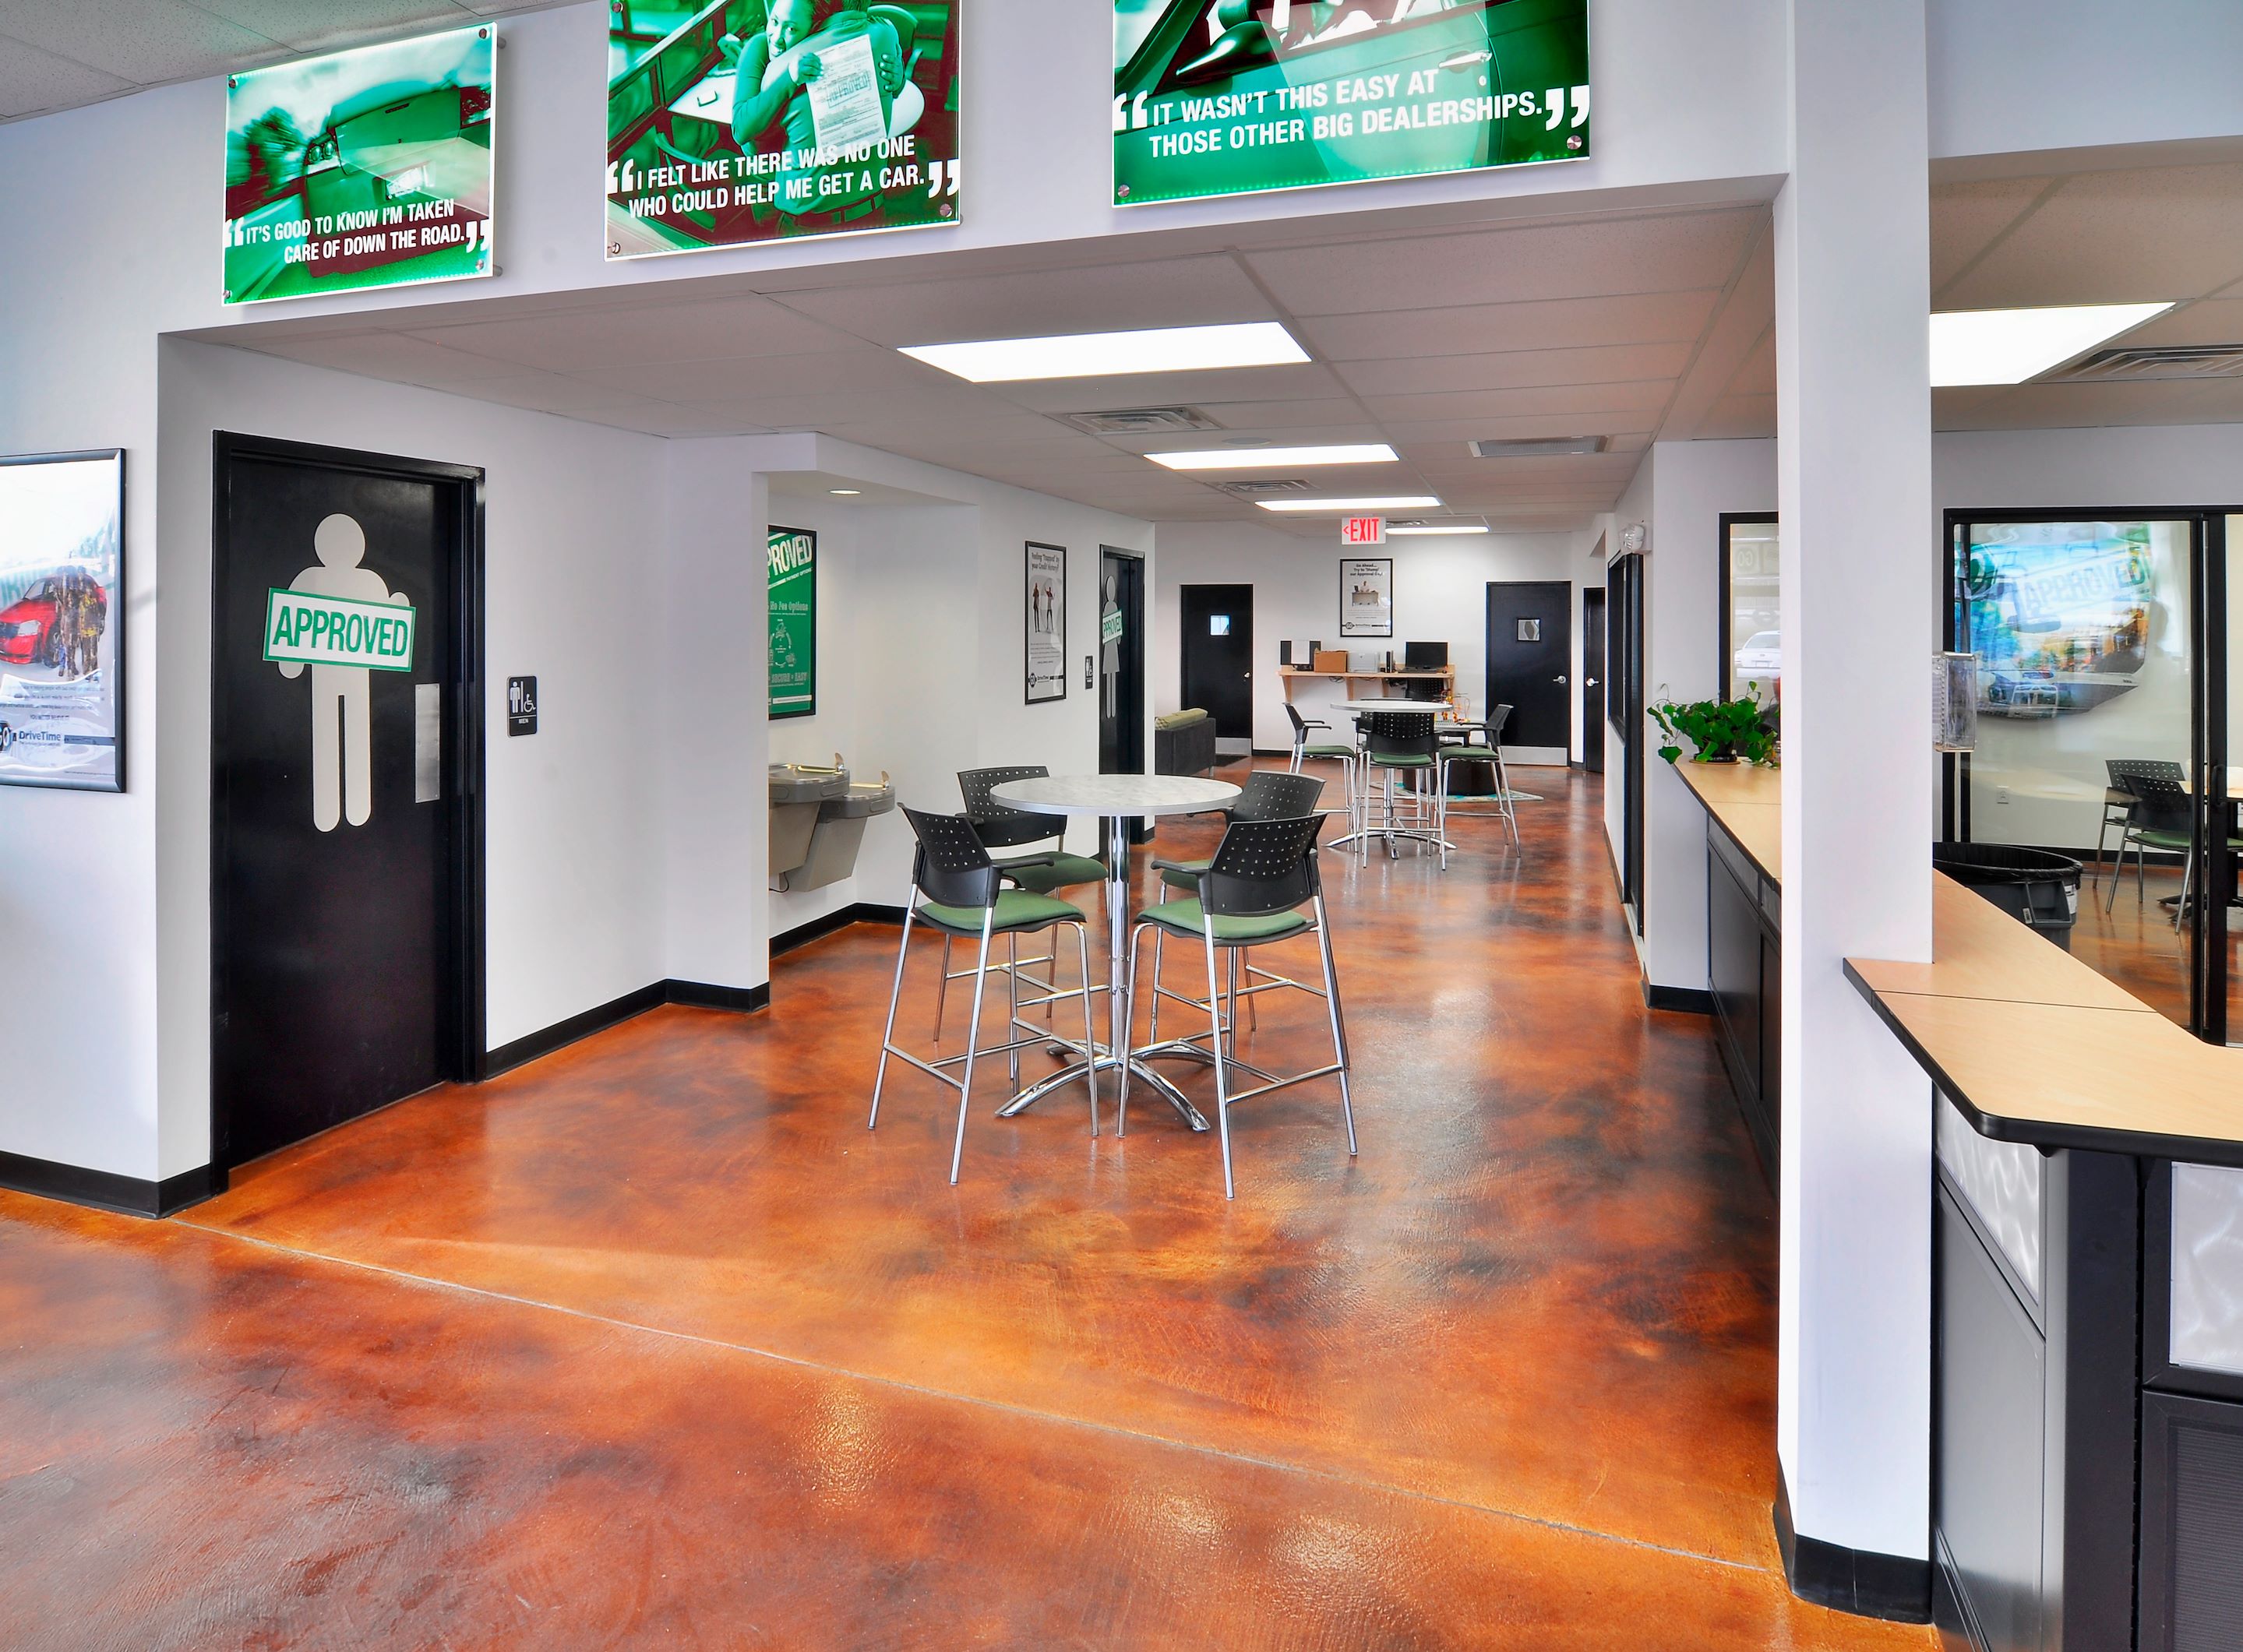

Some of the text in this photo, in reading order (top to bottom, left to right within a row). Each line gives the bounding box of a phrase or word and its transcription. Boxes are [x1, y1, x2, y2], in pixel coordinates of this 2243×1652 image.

[1149, 129, 1222, 158] THOSE
[1229, 118, 1305, 150] OTHER
[1314, 113, 1353, 140] BIG
[1362, 90, 1542, 135] DEALERSHIPS.
[1153, 103, 1173, 126] IT
[1181, 90, 1268, 122] WASN'T
[1275, 84, 1328, 111] THIS
[1336, 73, 1400, 104] EASY
[1407, 69, 1439, 95] AT
[648, 164, 686, 189] FELT
[691, 158, 729, 183] LIKE
[735, 151, 792, 177] THERE
[799, 146, 839, 169] WAS
[845, 141, 870, 163] NO
[877, 135, 915, 159] ONE
[628, 195, 666, 218] WHO
[672, 188, 728, 213] COULD
[734, 181, 780, 206] HELP
[785, 178, 812, 199] ME
[818, 171, 854, 197] GET
[859, 170, 873, 192] A
[879, 164, 925, 189] CAR.
[246, 224, 270, 244] IT'S
[274, 220, 311, 241] GOOD
[315, 215, 332, 234] TO
[337, 209, 378, 231] KNOW
[382, 206, 402, 226] I'M
[407, 198, 454, 222] TAKEN
[284, 242, 319, 264] CARE
[323, 239, 340, 259] OF
[344, 233, 386, 255] DOWN
[390, 229, 416, 250] THE
[421, 224, 465, 246] ROAD.
[1350, 518, 1379, 542] EXIT
[2023, 555, 2145, 613] APPROVED
[272, 605, 408, 657] APPROVED
[19, 731, 62, 741] DriveTime
